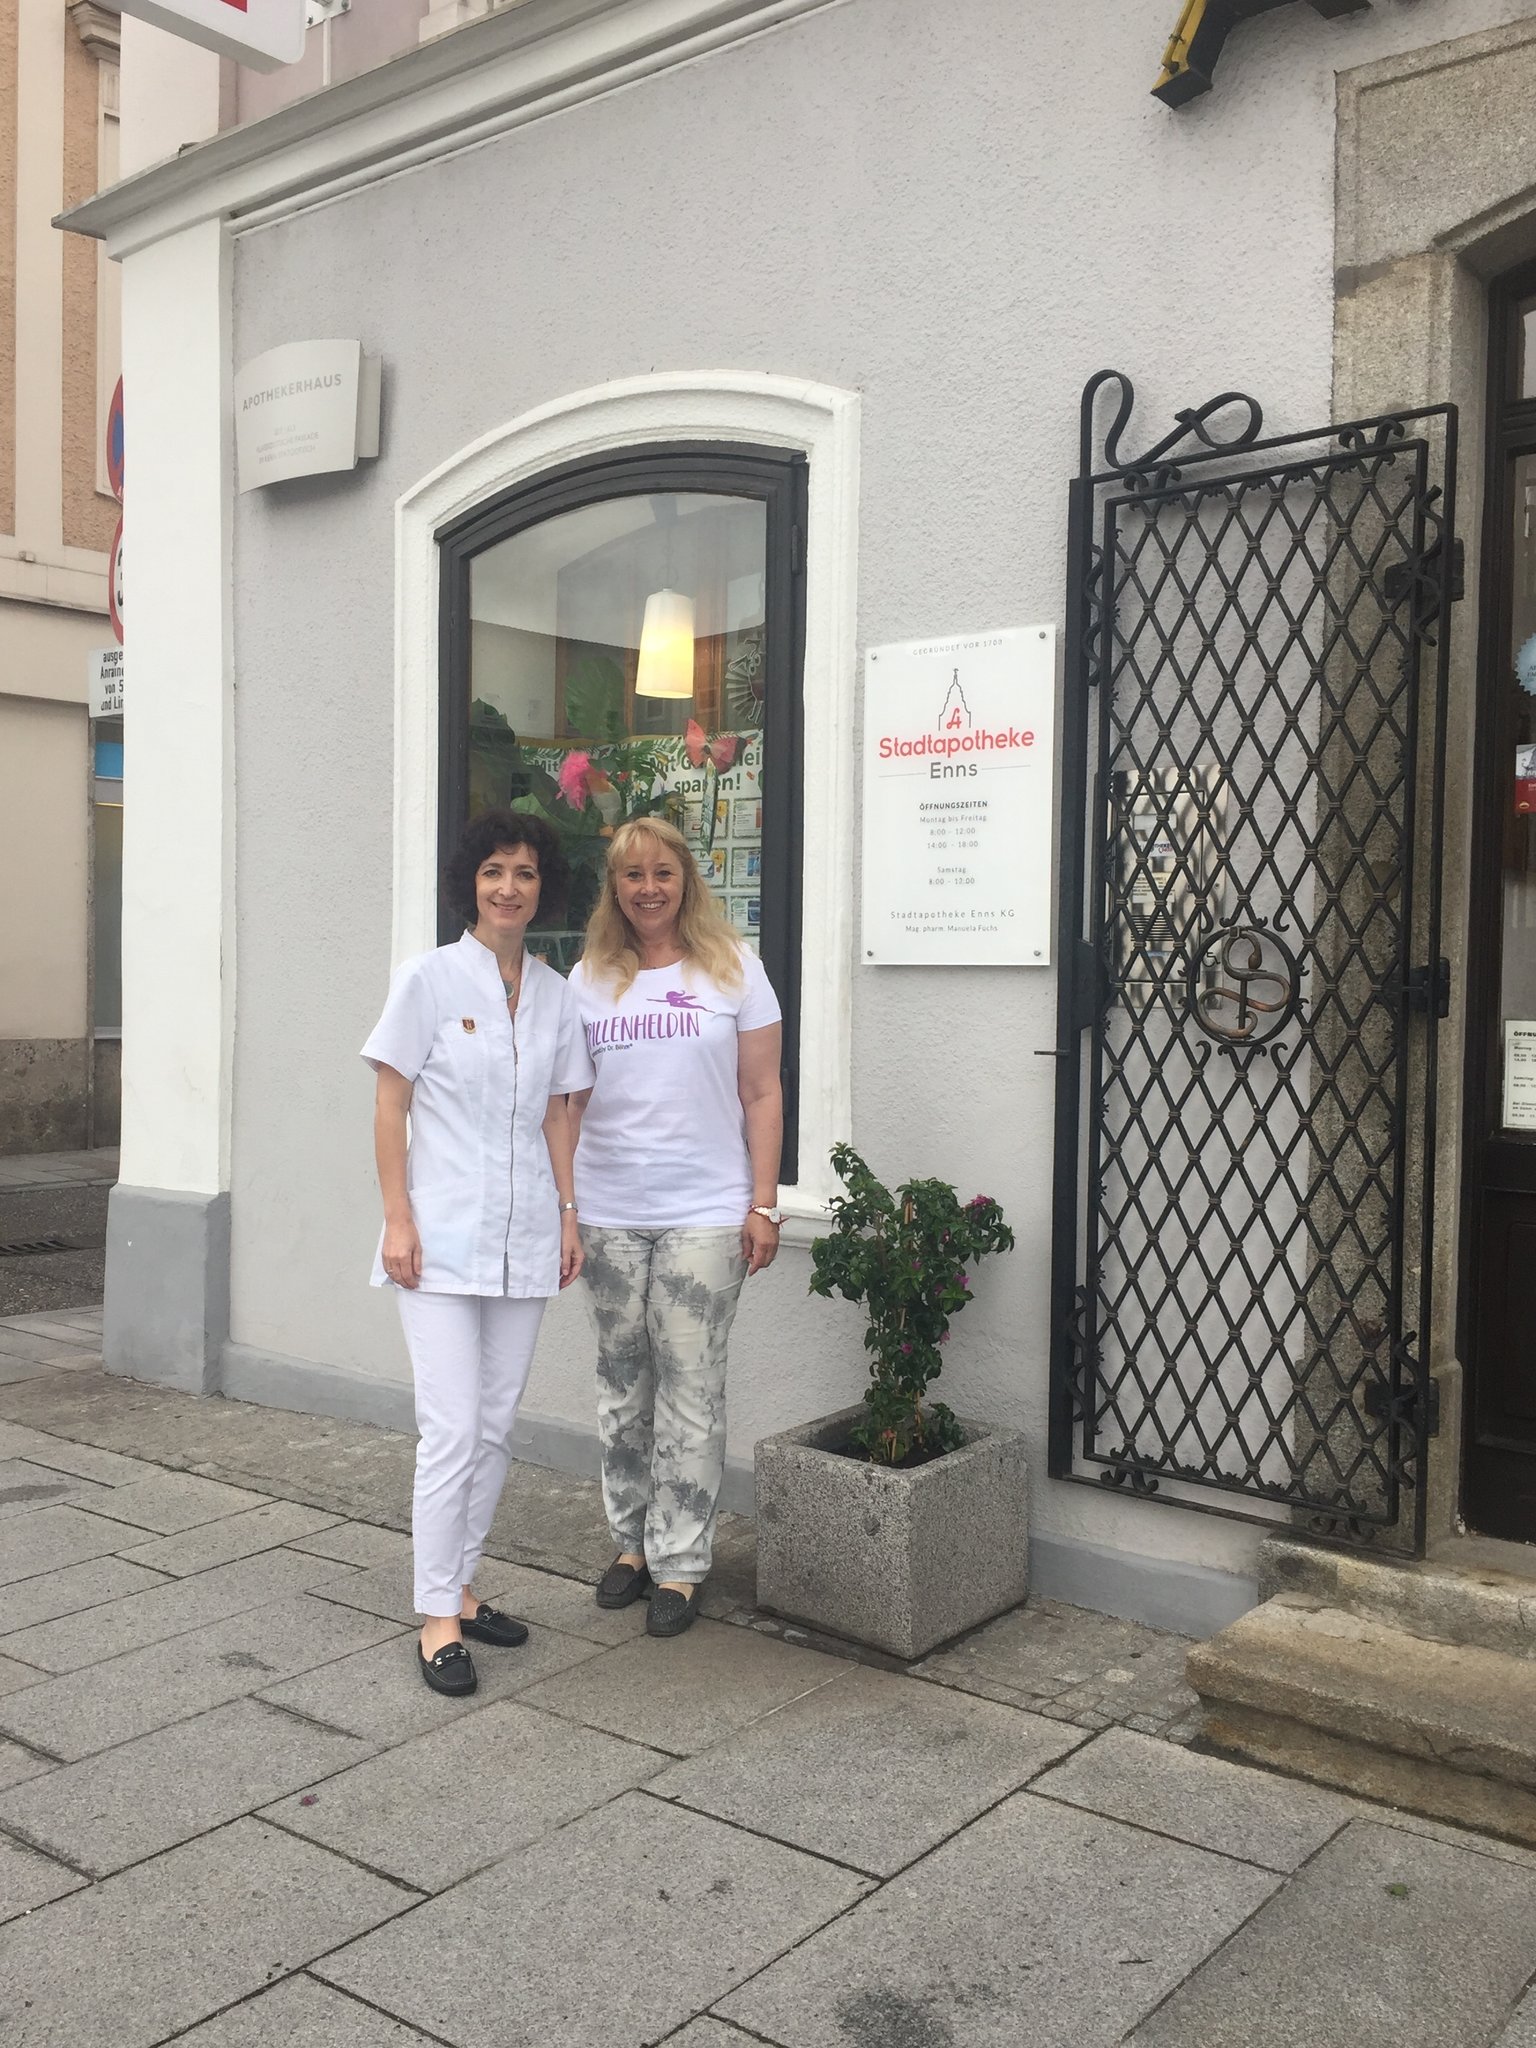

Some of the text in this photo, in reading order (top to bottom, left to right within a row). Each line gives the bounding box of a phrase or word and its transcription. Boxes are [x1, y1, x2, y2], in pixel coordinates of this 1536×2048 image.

[243, 373, 342, 411] APOTHEKERHAUS
[105, 683, 115, 695] von
[879, 728, 1034, 759] Stadtapotheke
[930, 761, 978, 780] Enns
[919, 801, 988, 811] ÖFFNUNGSZEITEN
[920, 815, 946, 824] Montag
[960, 814, 987, 823] Freitag
[955, 827, 976, 835] 12:00
[927, 841, 947, 849] 14:00
[937, 866, 967, 874] Samstag
[890, 908, 1015, 920] Stadtapotheke Enns KG
[947, 924, 976, 932] Manuela
[978, 924, 998, 932] Fuchs
